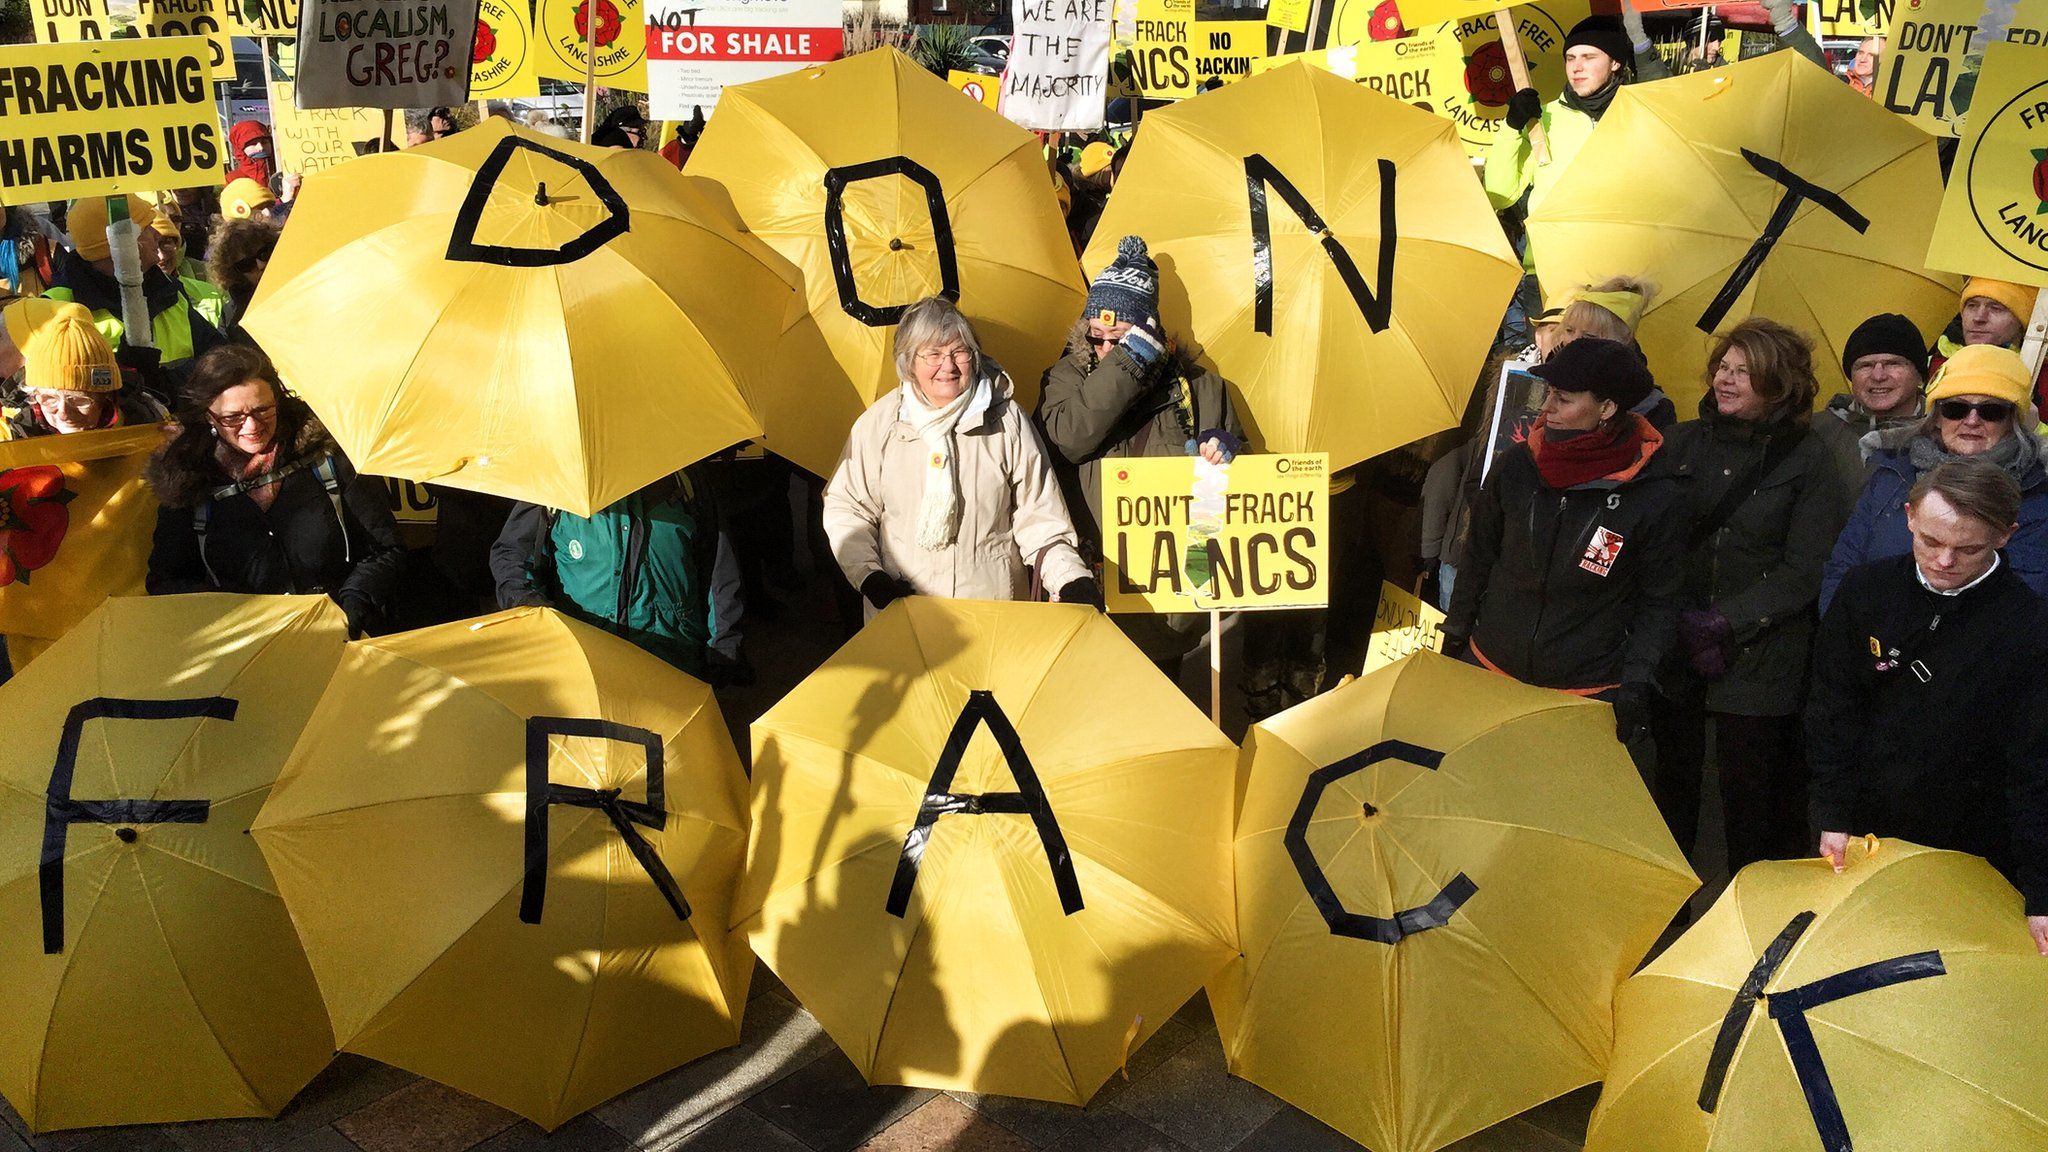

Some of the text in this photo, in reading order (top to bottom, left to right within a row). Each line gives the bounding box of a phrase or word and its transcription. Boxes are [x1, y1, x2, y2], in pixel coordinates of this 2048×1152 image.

[650, 6, 704, 36] NOT
[1021, 0, 1106, 22] WE ARE
[661, 31, 811, 55] FOR SHALE
[1022, 33, 1083, 58] THE
[1135, 20, 1187, 43] FRACK
[1209, 31, 1232, 51] NO
[1453, 14, 1555, 53] FRAC FREE
[1897, 21, 1978, 54] DON'T
[346, 39, 450, 87] GREG?
[559, 36, 630, 67] LANCSHIRE
[0, 55, 205, 117] FRACKING
[0, 122, 218, 188] HARMS US
[301, 139, 344, 154] OUR
[1116, 491, 1314, 527] DON'T FRACK
[1117, 527, 1317, 600] LANCS
